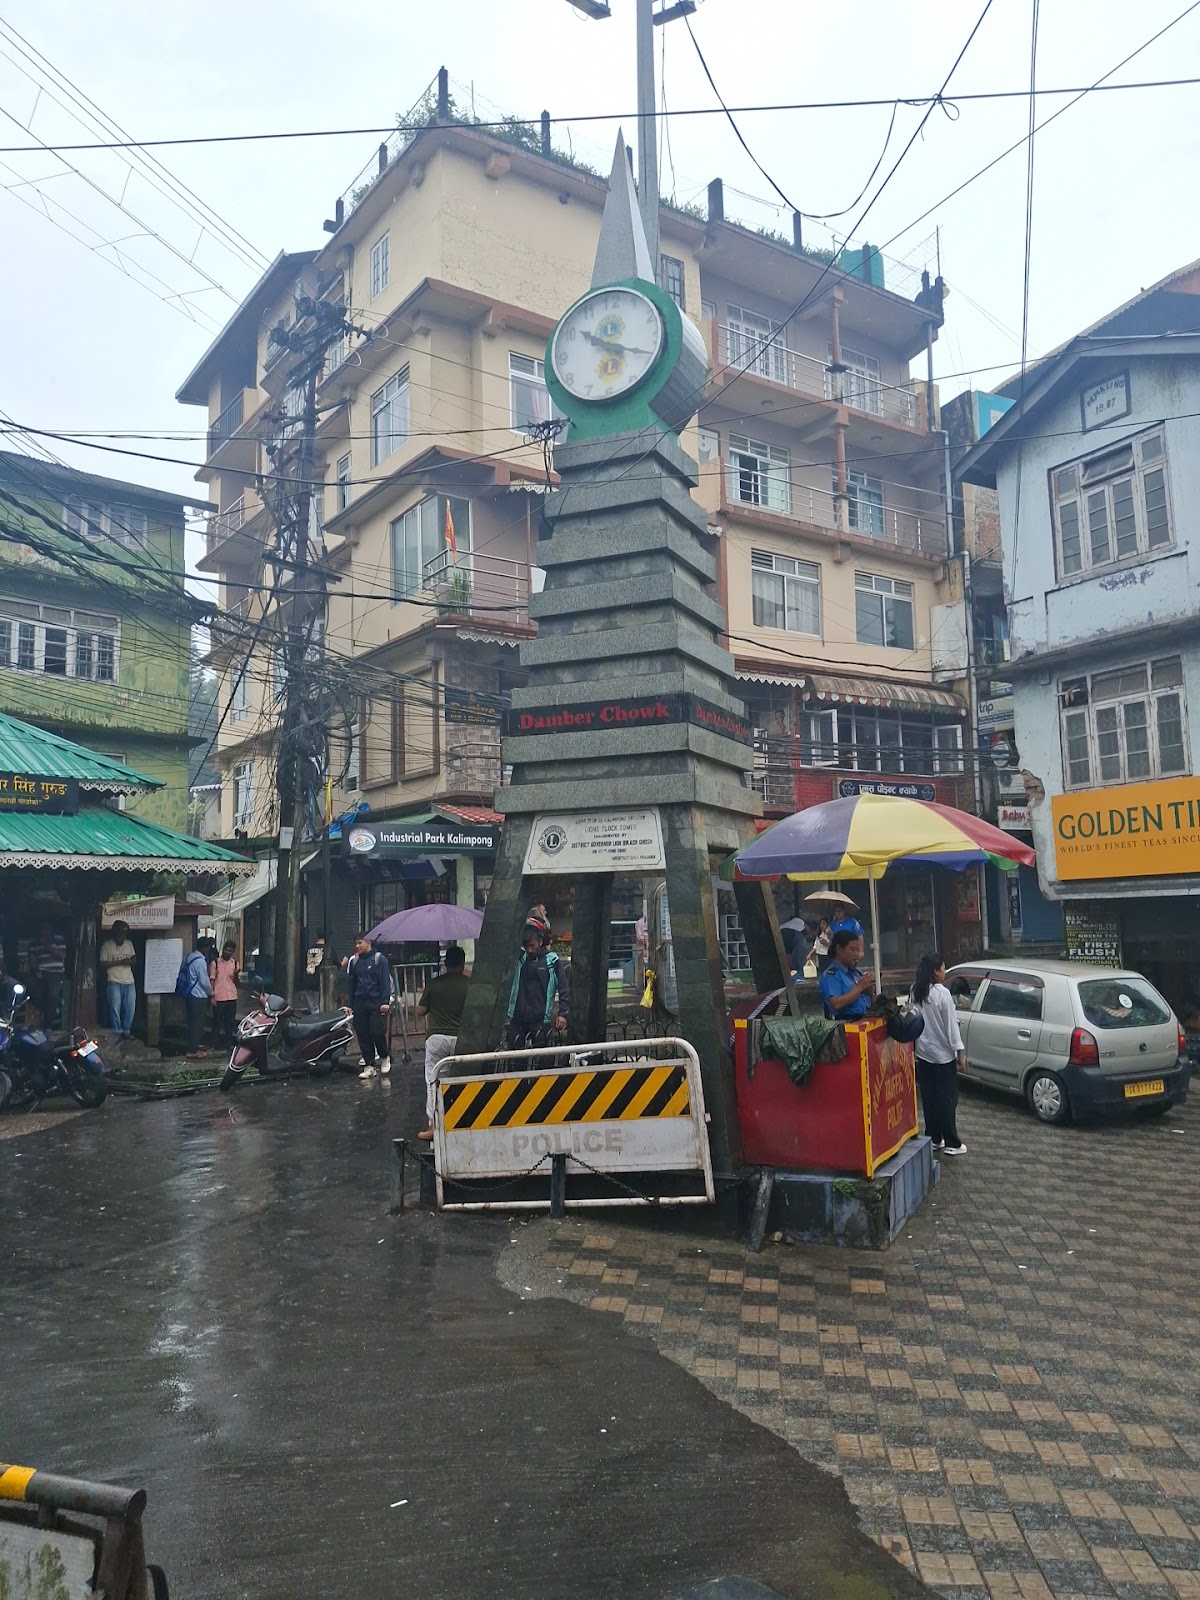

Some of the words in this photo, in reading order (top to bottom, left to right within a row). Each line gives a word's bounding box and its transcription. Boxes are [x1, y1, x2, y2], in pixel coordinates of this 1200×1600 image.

[559, 352, 568, 366] 9
[979, 701, 994, 714] trip
[519, 711, 595, 730] Damber
[600, 702, 670, 723] Chowk
[1058, 804, 1163, 840] GOLDEN
[380, 832, 423, 843] Industrial
[425, 832, 445, 844] Park
[448, 833, 493, 847] Kalimpong
[1060, 843, 1100, 853] WORLD'S
[1104, 840, 1138, 850] FINEST
[1142, 837, 1167, 847] TEAS
[142, 907, 169, 917] CHOWK
[1070, 948, 1116, 956] FLUSH
[512, 1128, 624, 1158] POLICE
